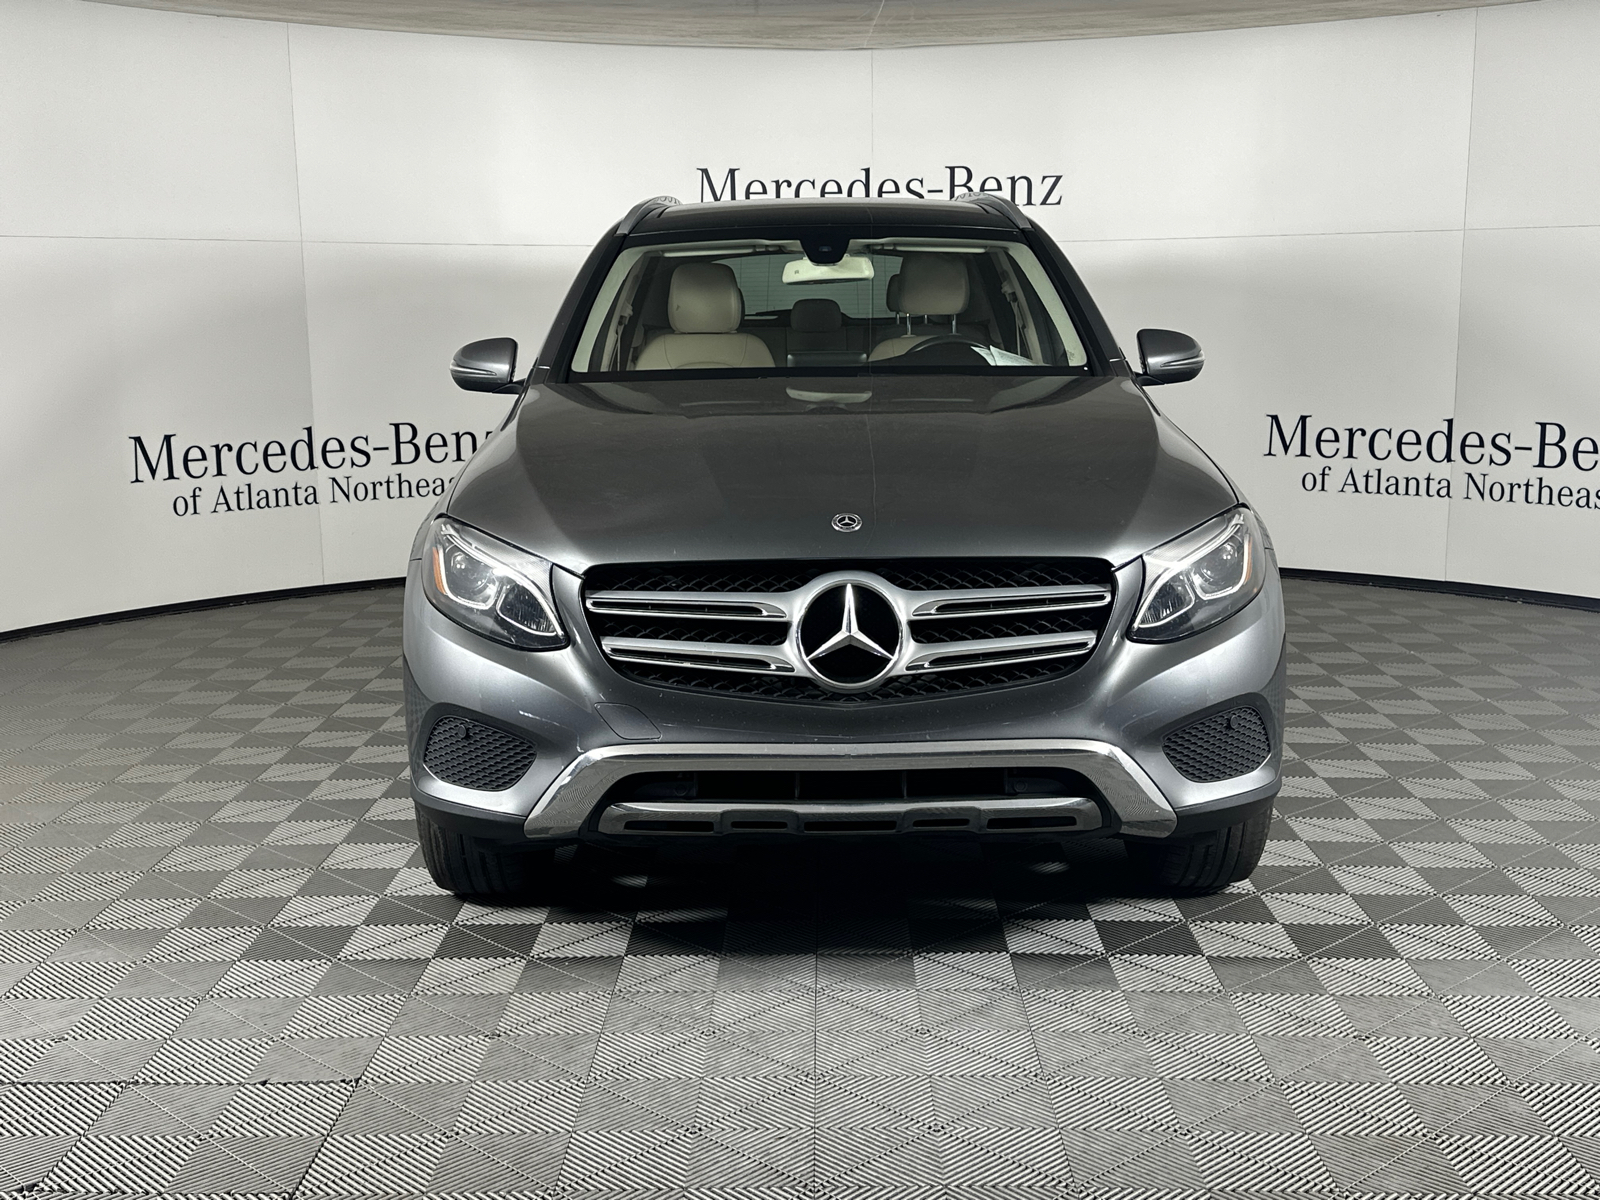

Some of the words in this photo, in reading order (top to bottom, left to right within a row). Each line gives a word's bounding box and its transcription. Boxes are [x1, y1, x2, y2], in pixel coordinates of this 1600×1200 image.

[696, 165, 1063, 207] Mercedes-Benz
[128, 421, 494, 484] Mercedes-Ben
[172, 486, 203, 517] of
[210, 480, 319, 514] Atlanta
[329, 472, 454, 504] Northea
[1301, 465, 1332, 492] of
[1338, 465, 1452, 499] Atlanta
